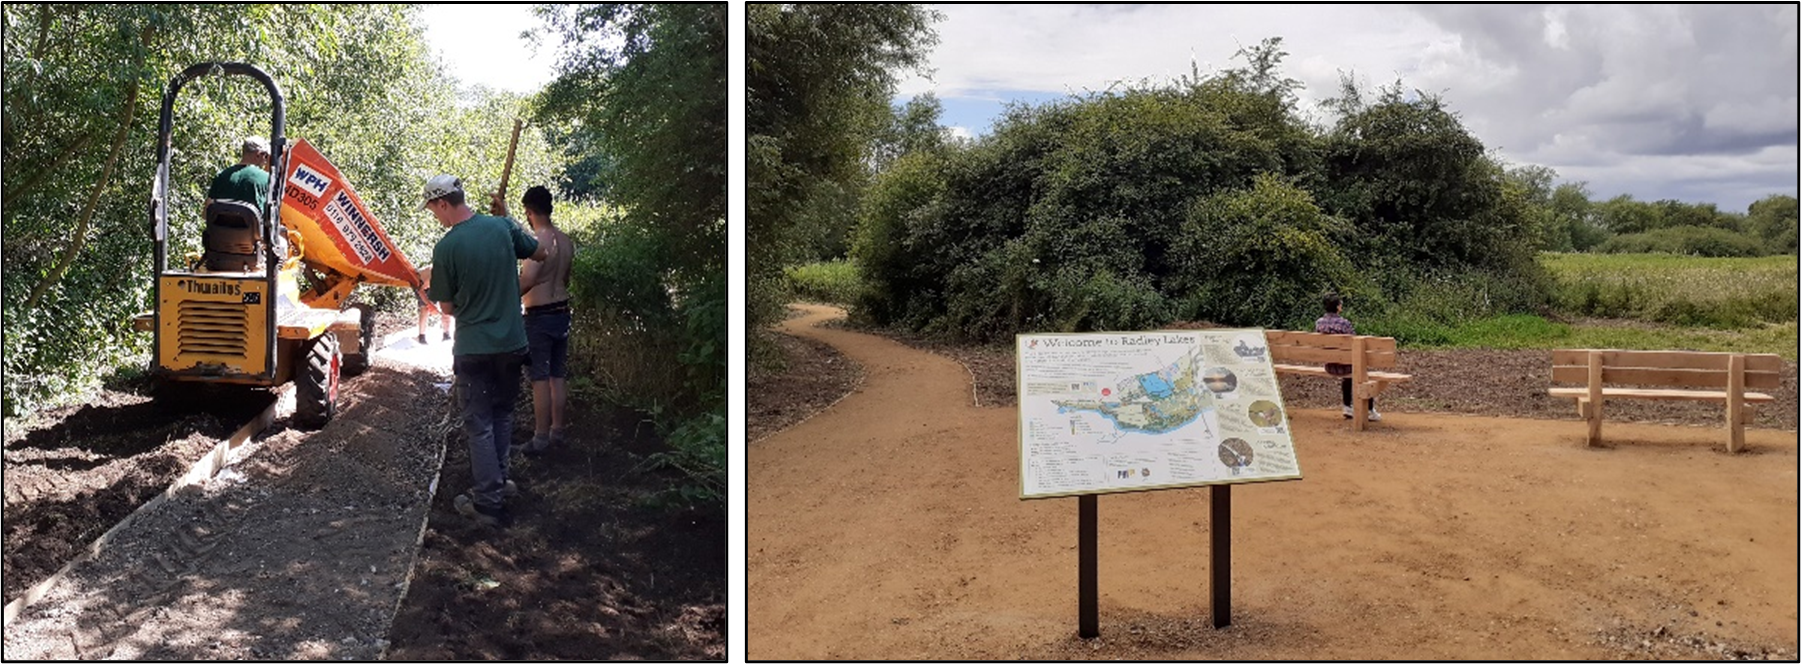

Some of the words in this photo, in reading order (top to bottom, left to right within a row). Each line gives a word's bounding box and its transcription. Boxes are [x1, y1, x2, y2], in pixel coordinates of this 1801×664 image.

[295, 167, 327, 191] WPH
[337, 191, 390, 260] WINNERSH
[1042, 337, 1102, 348] Welcome
[1105, 338, 1118, 347] to
[1121, 336, 1161, 347] Radley
[1163, 335, 1196, 345] Lakes
